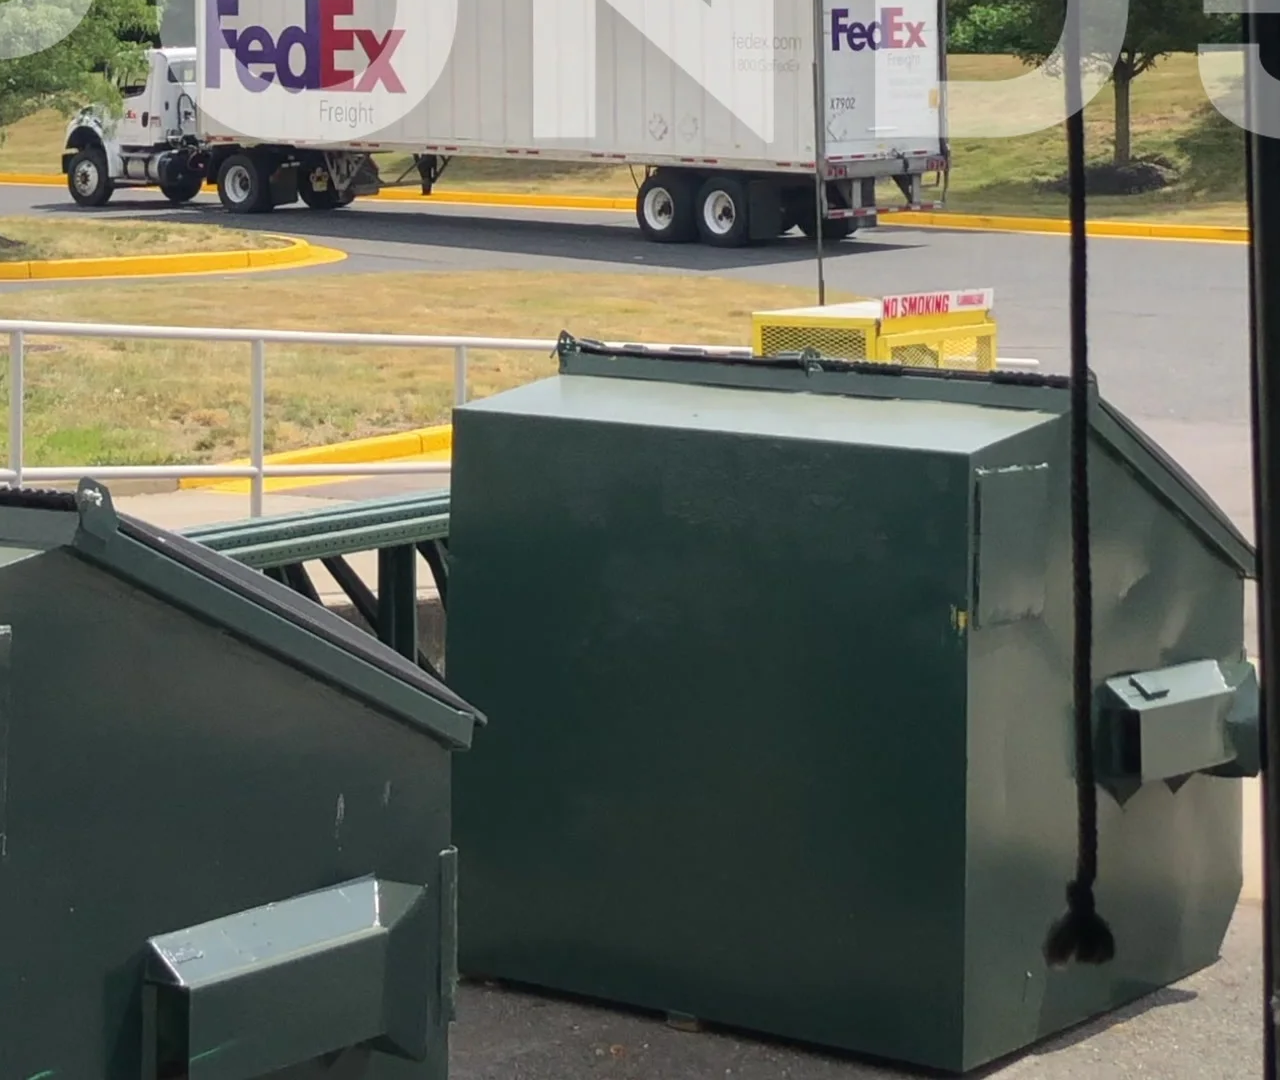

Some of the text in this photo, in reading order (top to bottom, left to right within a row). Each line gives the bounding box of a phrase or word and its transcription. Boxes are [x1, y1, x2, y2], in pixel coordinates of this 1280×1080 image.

[831, 7, 926, 51] FedEx
[320, 100, 374, 127] Freight
[883, 298, 898, 318] NO
[901, 294, 950, 317] SMOKING
